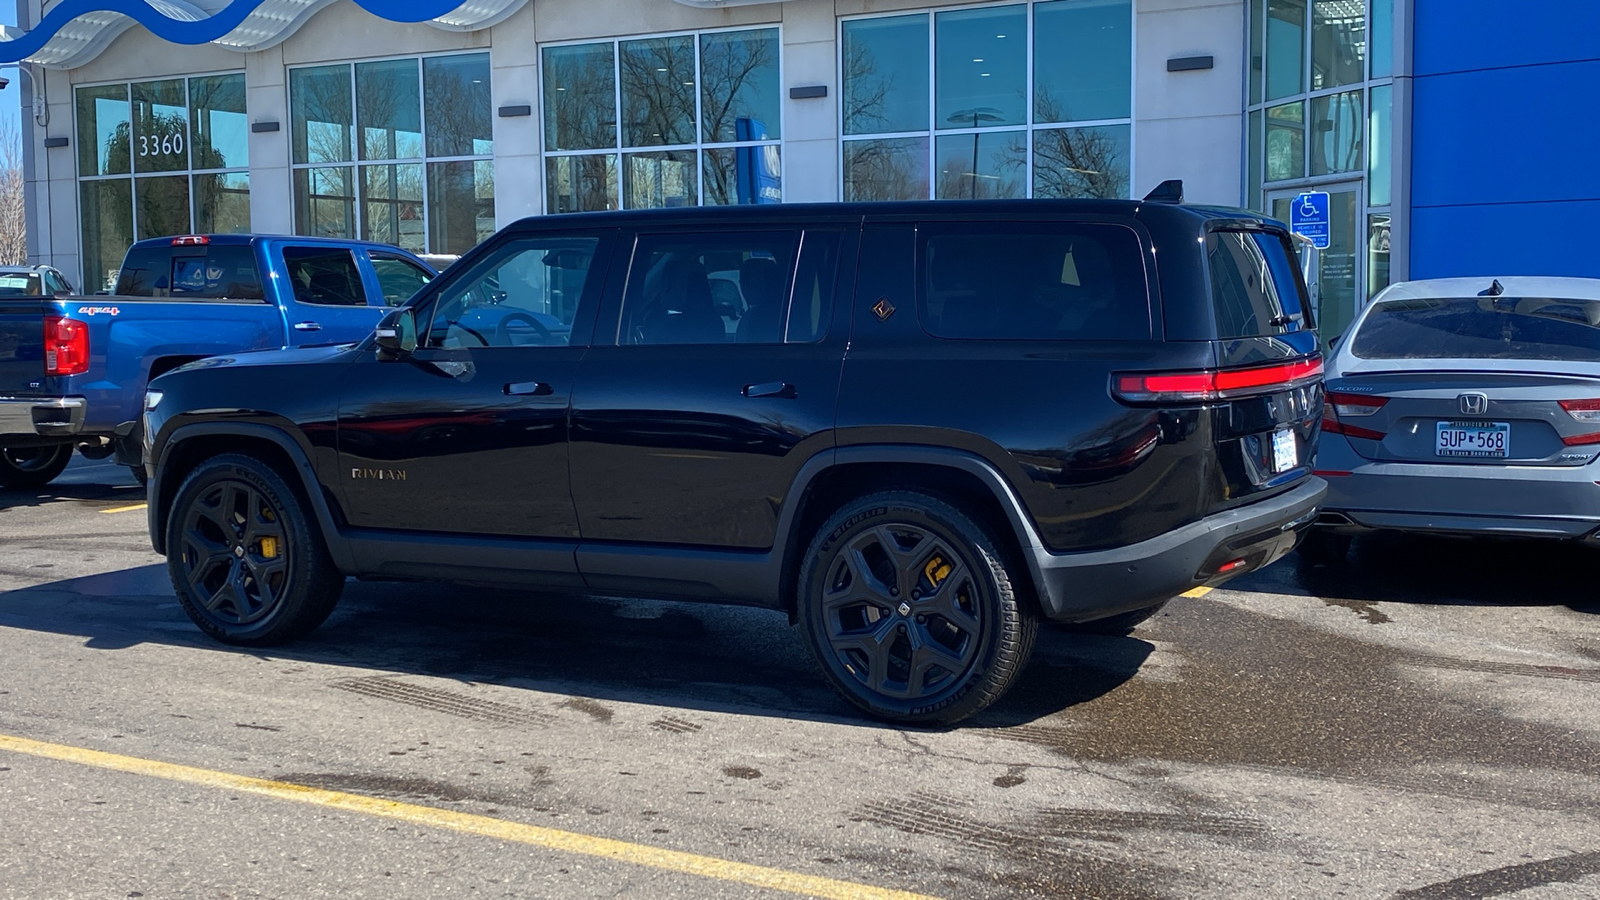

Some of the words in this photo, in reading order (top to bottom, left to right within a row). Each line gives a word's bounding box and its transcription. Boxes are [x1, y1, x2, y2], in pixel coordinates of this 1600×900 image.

[139, 133, 183, 157] 3360
[1440, 430, 1467, 448] SUP
[1477, 431, 1504, 449] 568
[351, 468, 406, 480] RIVIAN
[833, 507, 885, 539] MICHELIN
[912, 686, 968, 714] MICHELIN
